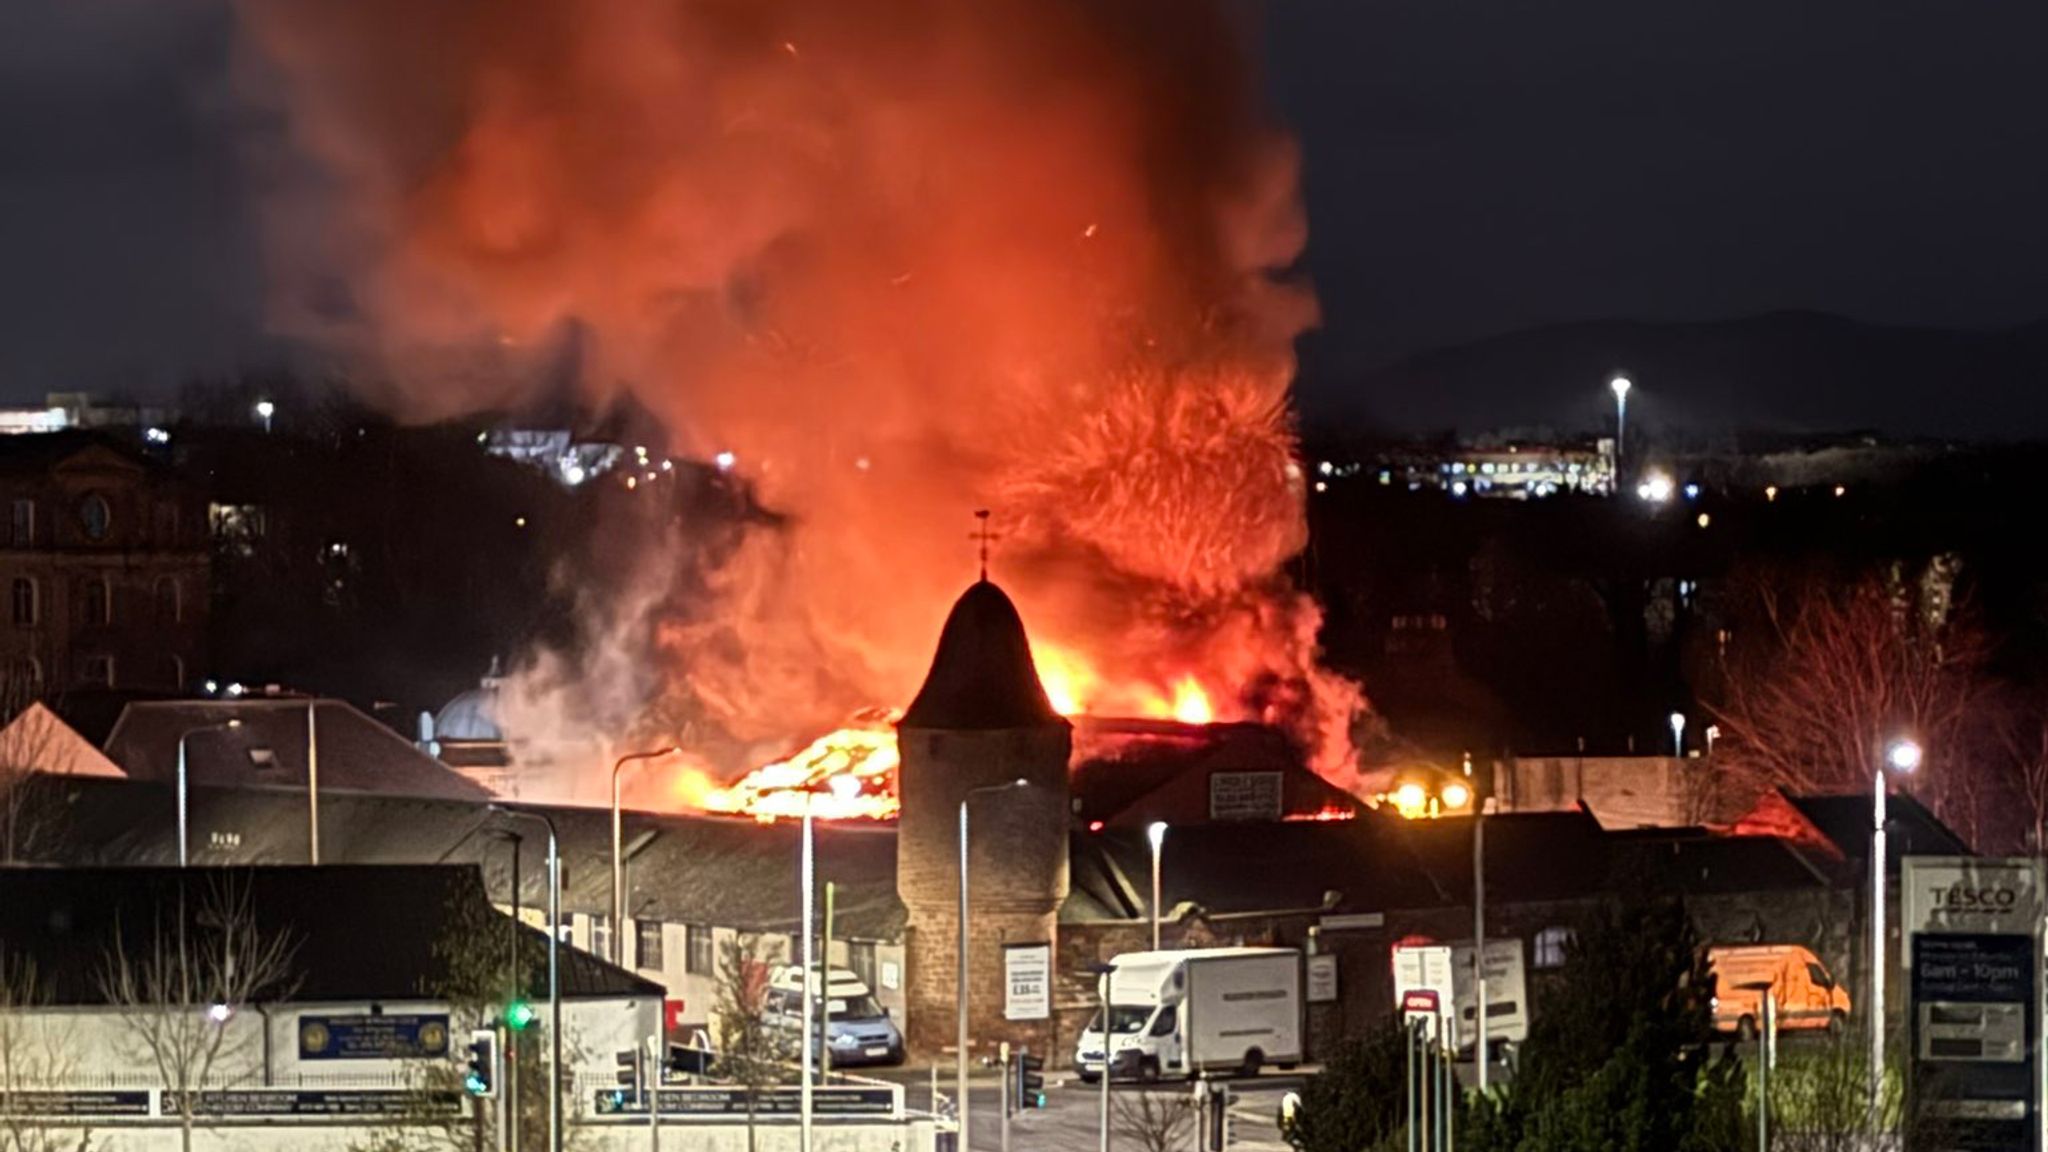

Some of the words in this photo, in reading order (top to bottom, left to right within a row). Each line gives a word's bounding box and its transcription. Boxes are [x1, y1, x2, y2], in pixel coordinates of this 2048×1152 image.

[1929, 886, 2016, 906] TESCO
[1920, 962, 1956, 979] 6am
[1973, 963, 2019, 984] 10pm
